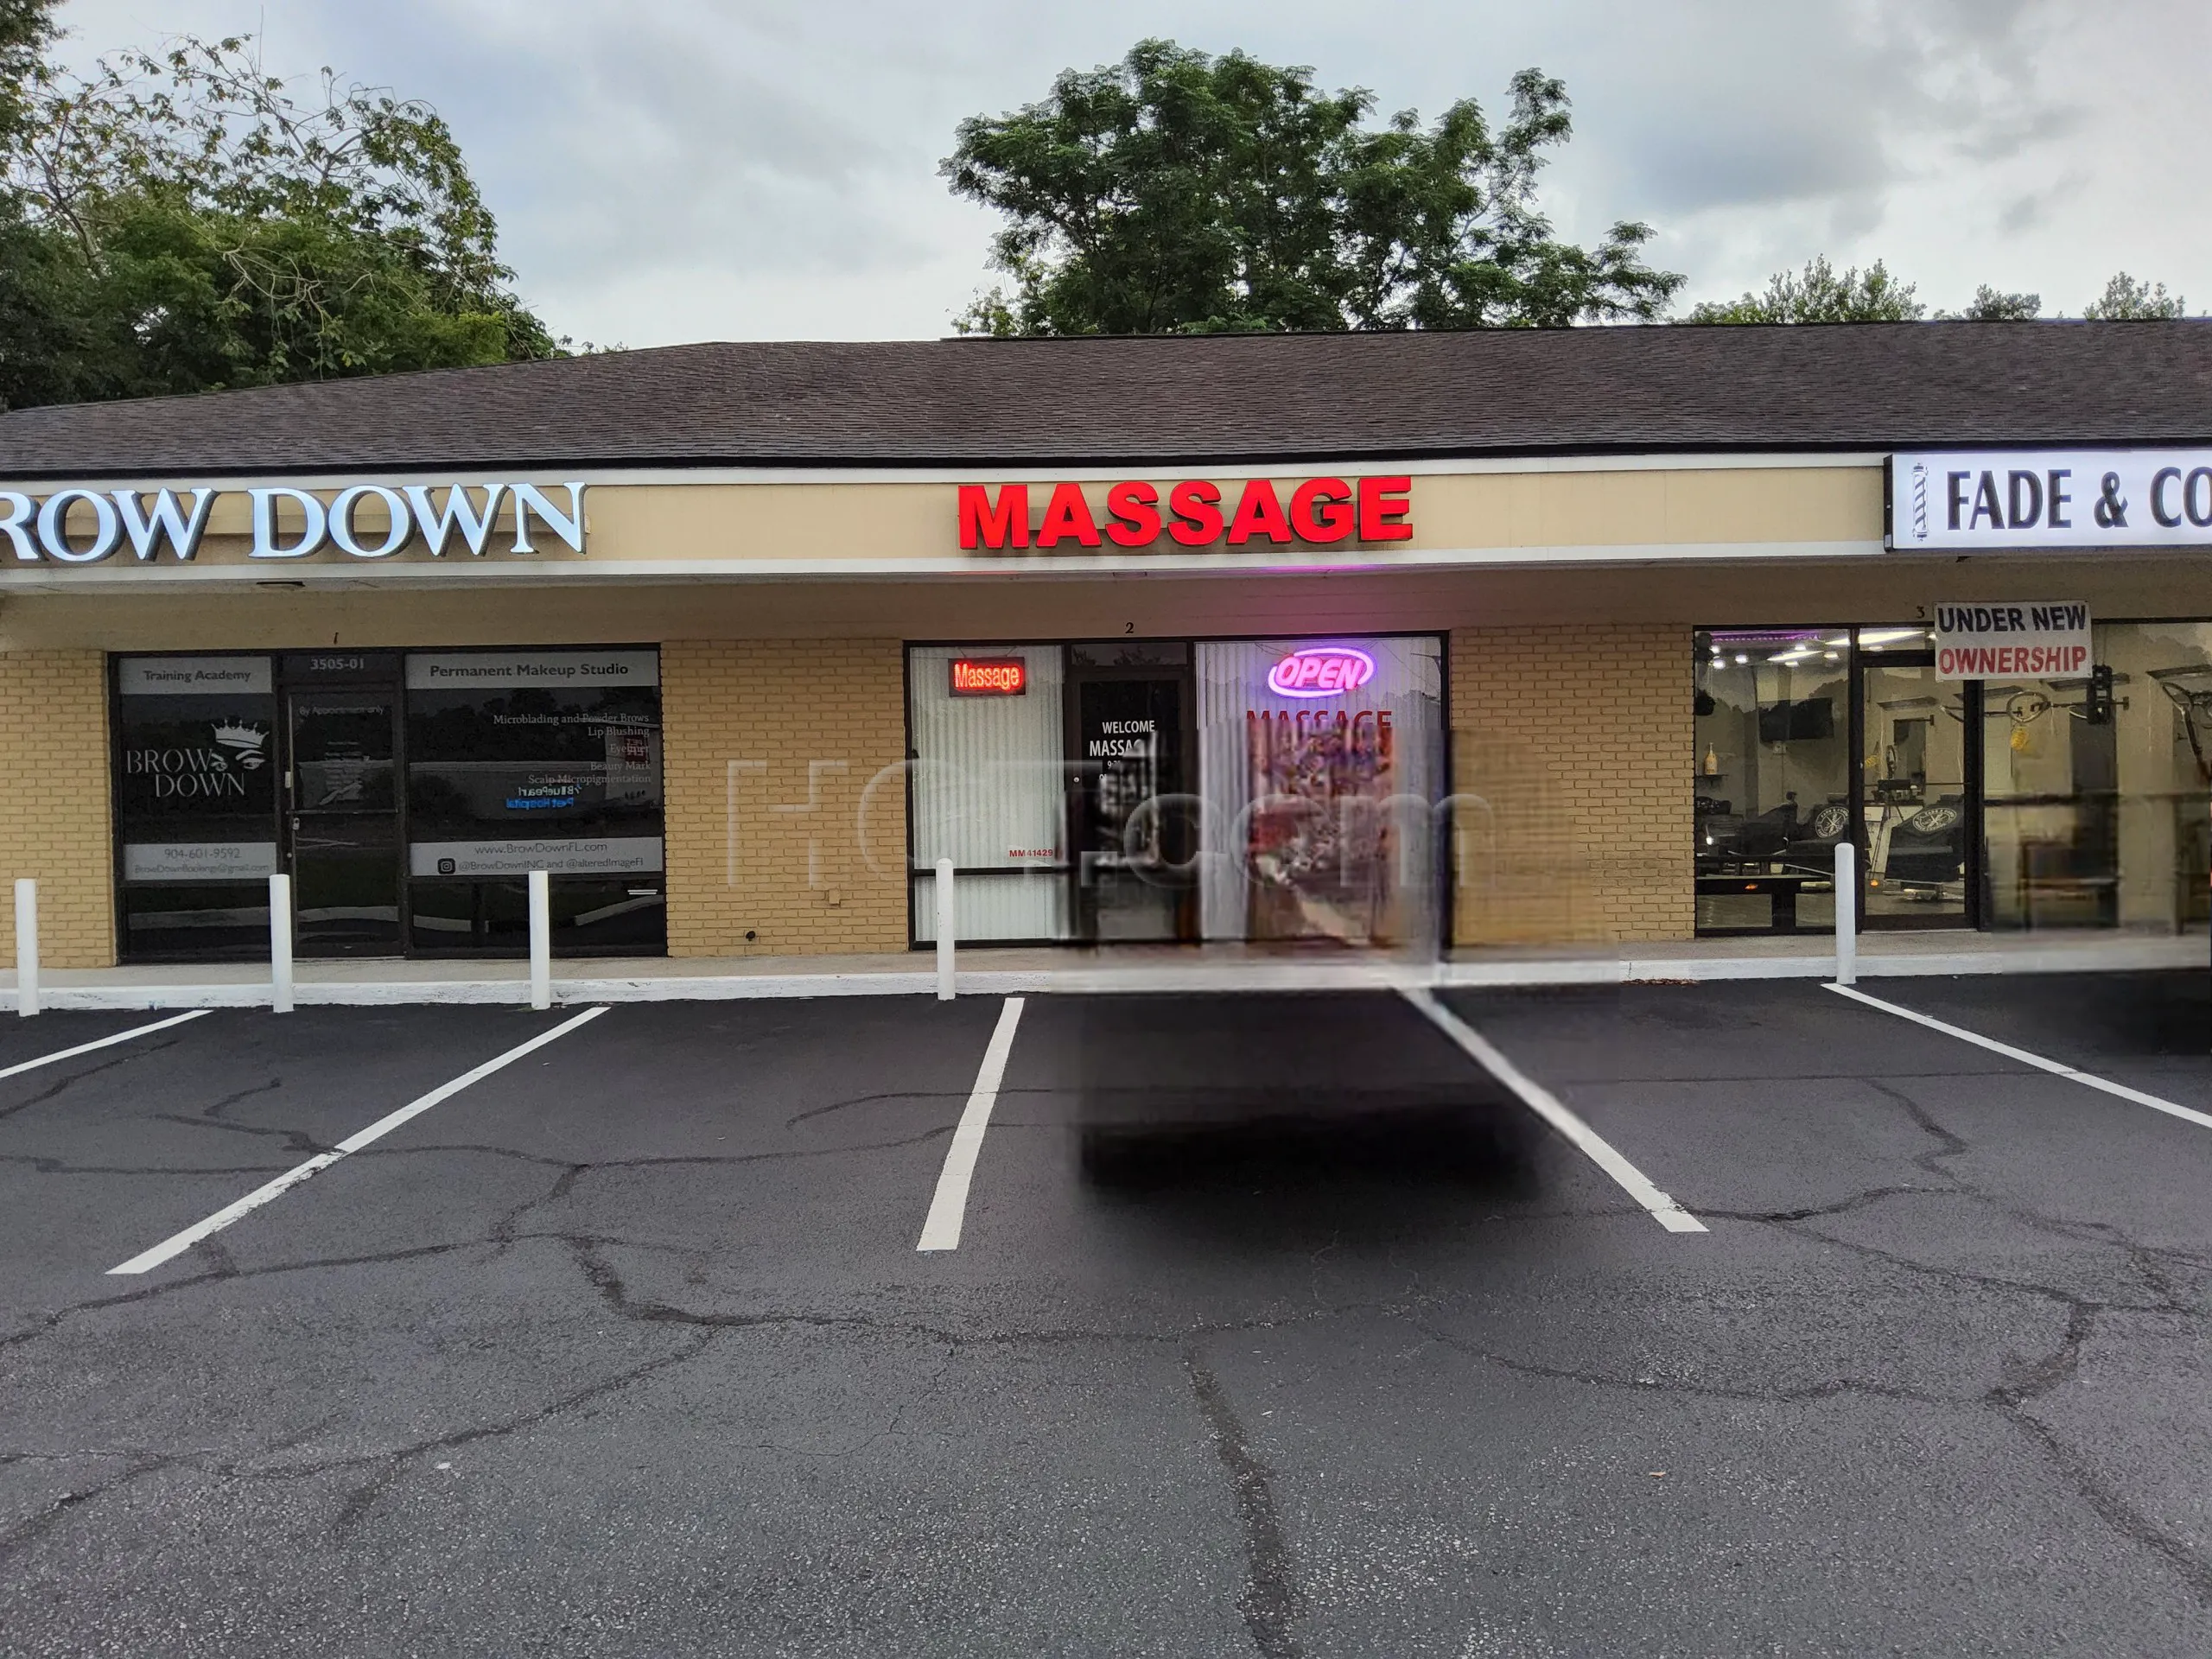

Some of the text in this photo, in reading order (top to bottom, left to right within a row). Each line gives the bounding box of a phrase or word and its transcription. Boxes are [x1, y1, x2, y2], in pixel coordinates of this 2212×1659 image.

[1947, 468, 2072, 531] FADE
[2094, 471, 2130, 529] &
[247, 481, 588, 559] DOWN
[957, 476, 1414, 550] MASSAGE
[1916, 606, 1925, 619] 3
[1937, 604, 2086, 633] UNDER NEW
[1125, 621, 1135, 634] 2
[310, 658, 365, 671] 3505-01
[1938, 645, 2087, 675] OWNERSHIP
[143, 670, 251, 683] Training Academy
[429, 663, 629, 679] Permanent Makeup Studio
[954, 663, 1020, 690] Massage
[1274, 654, 1365, 690] OPEN
[493, 715, 560, 728] Microblading
[562, 714, 580, 725] and
[620, 712, 649, 723] Brows
[1102, 720, 1156, 734] WELCOME
[588, 726, 650, 739] Lip Blushing
[127, 748, 211, 774] BROW
[590, 760, 651, 774] Beauty Mark
[155, 772, 245, 798] DOWN
[528, 772, 651, 788] Scalp Micropigmentation
[164, 848, 242, 860] 904-601-9592
[474, 842, 607, 855] www.BrowDownFL.com
[459, 858, 543, 871] @BrowDownINC
[547, 859, 563, 868] and
